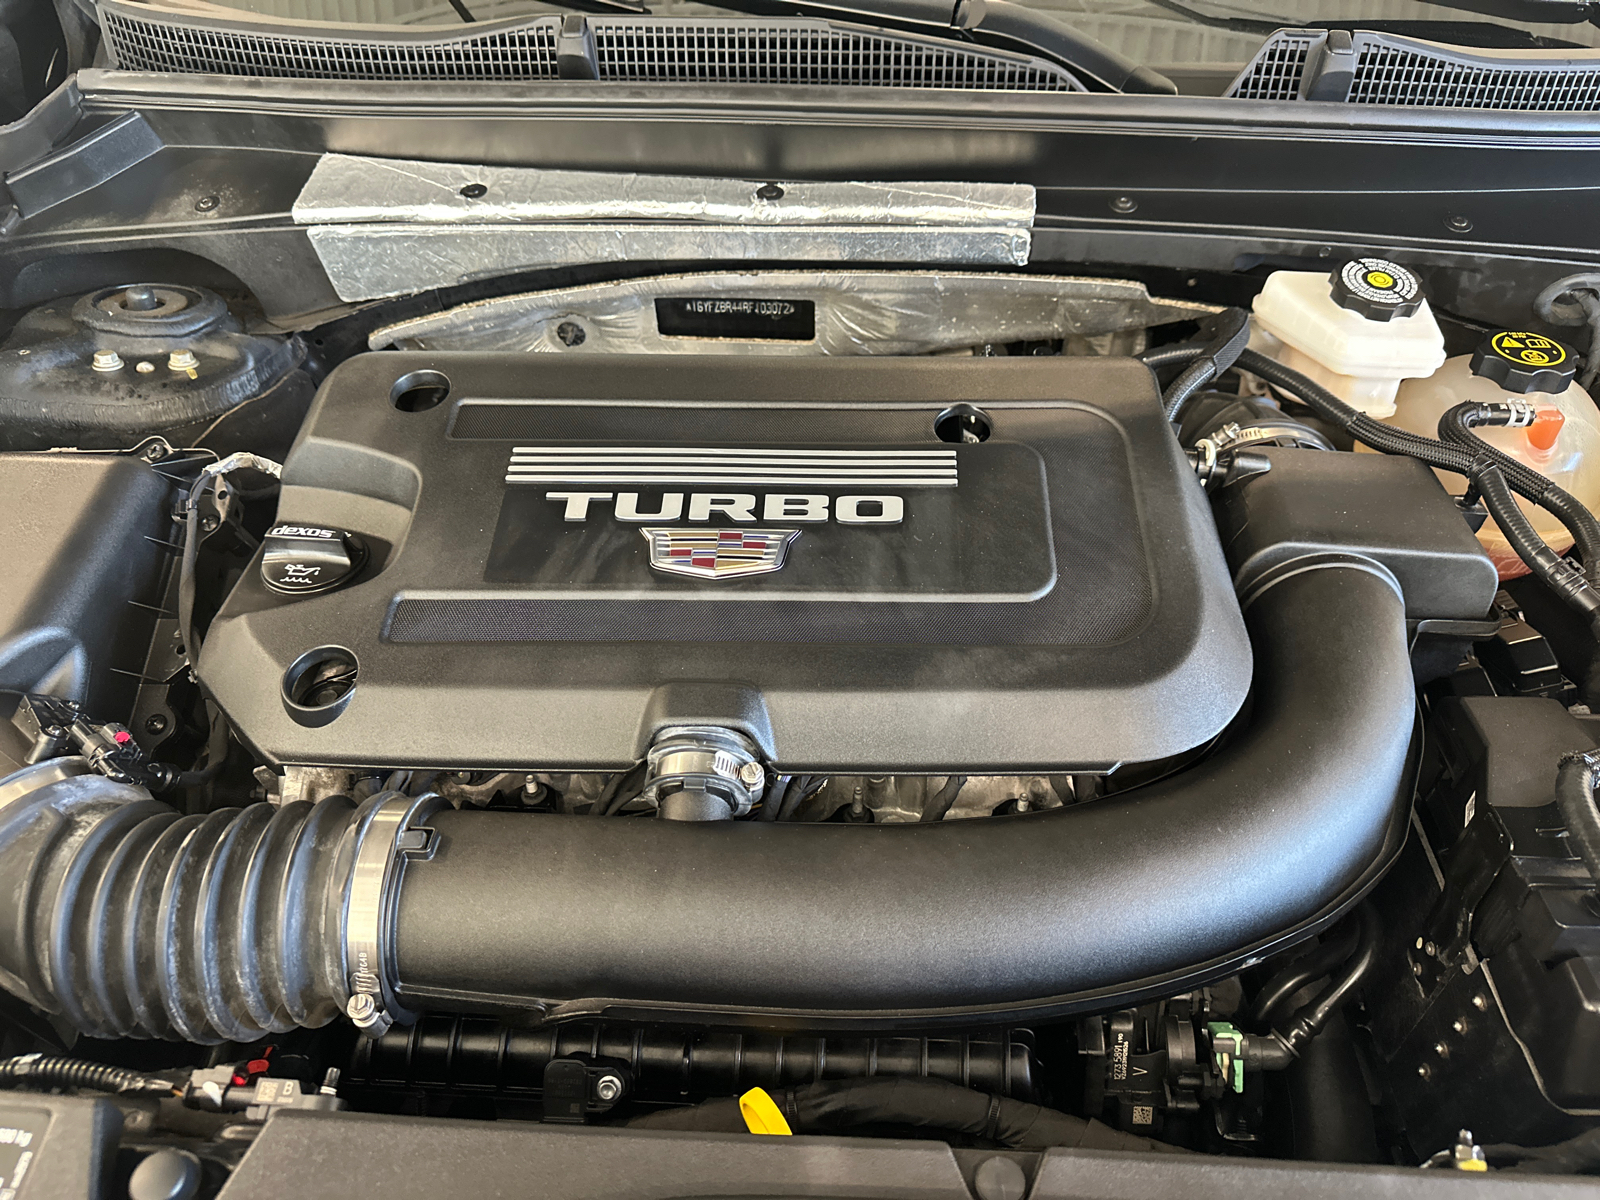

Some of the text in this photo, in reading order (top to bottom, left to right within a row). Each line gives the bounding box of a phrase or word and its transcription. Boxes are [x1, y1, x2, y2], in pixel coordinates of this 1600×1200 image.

[546, 492, 904, 525] TURBO
[271, 525, 336, 538] dexos
[282, 1081, 294, 1095] B
